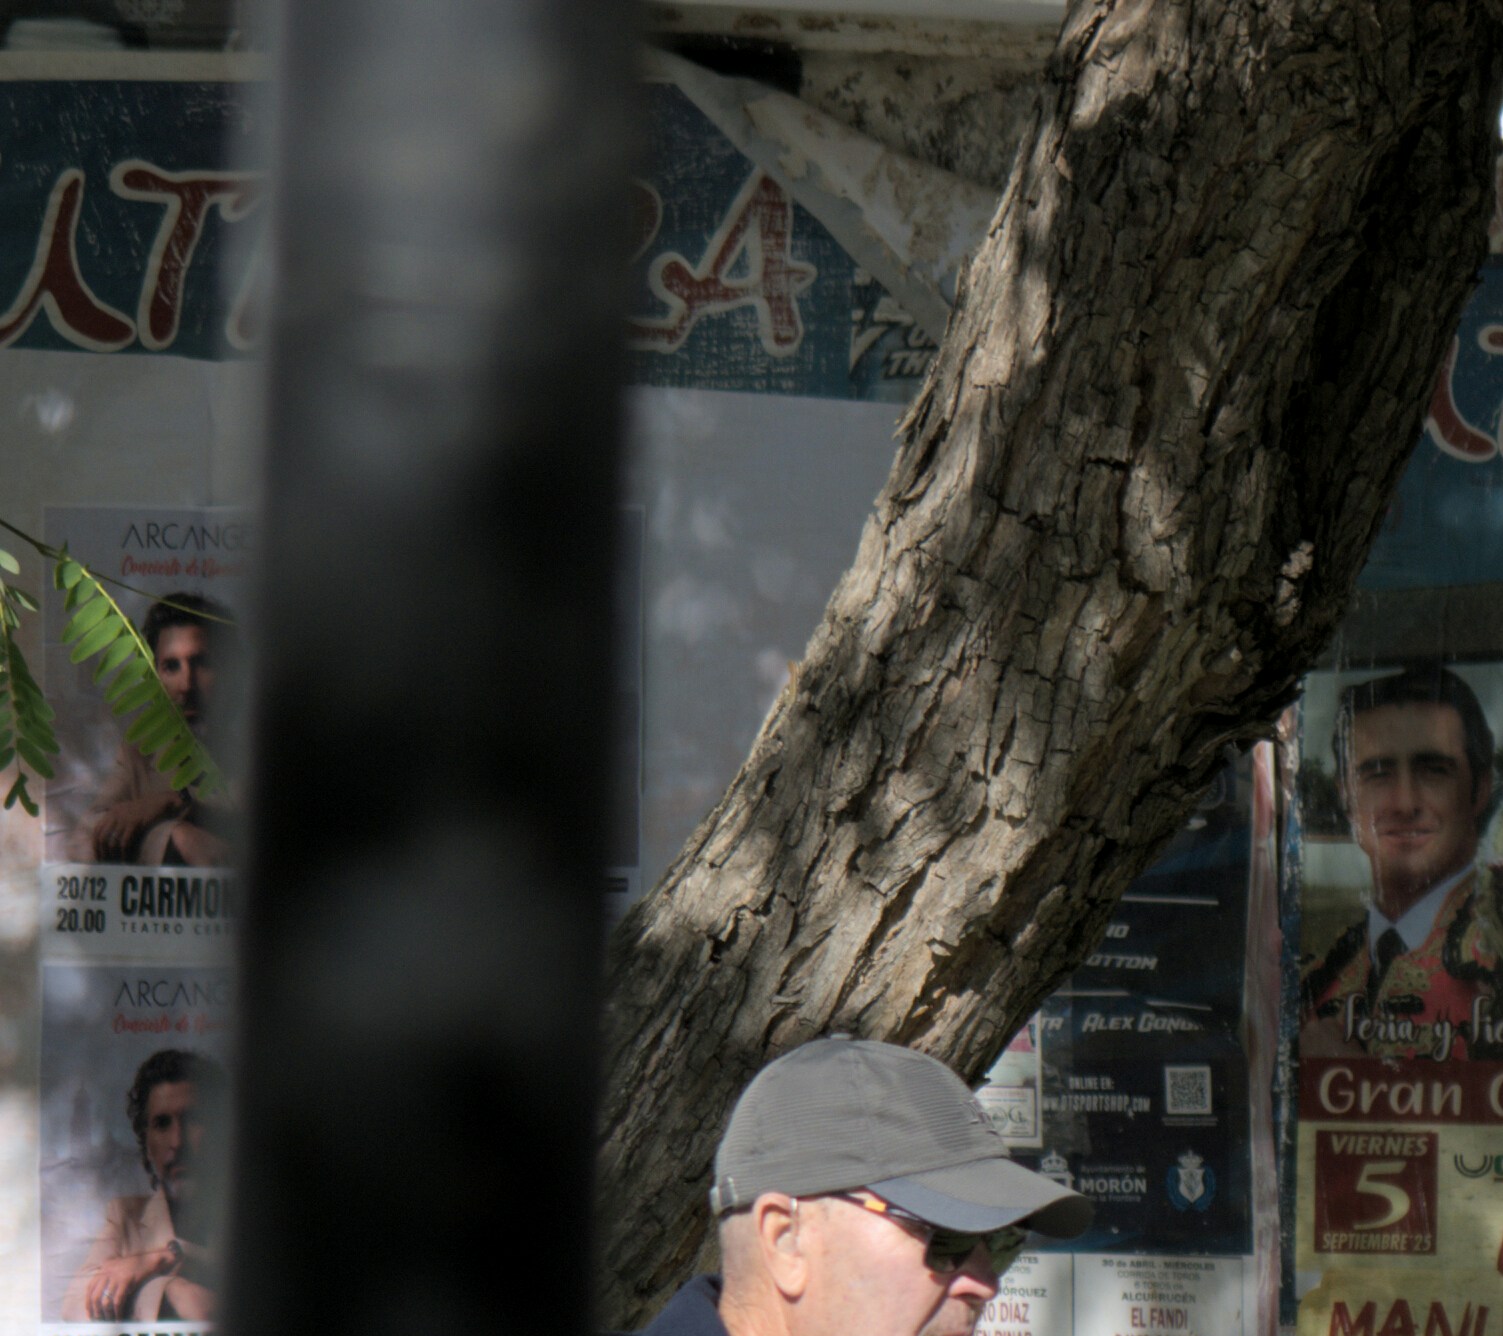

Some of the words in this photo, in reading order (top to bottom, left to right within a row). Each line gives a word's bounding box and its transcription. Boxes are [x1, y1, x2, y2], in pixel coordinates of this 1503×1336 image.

[57, 876, 108, 901] 20/12
[56, 908, 107, 934] 20.00
[121, 921, 184, 936] TEATRO
[1345, 993, 1426, 1043] Feria
[1431, 1015, 1456, 1061] y
[1320, 1065, 1463, 1116] Gran
[1331, 1134, 1428, 1157] VIERNES
[1353, 1160, 1411, 1230] 5
[1131, 1307, 1145, 1328] EL
[1150, 1308, 1188, 1331] FANDI
